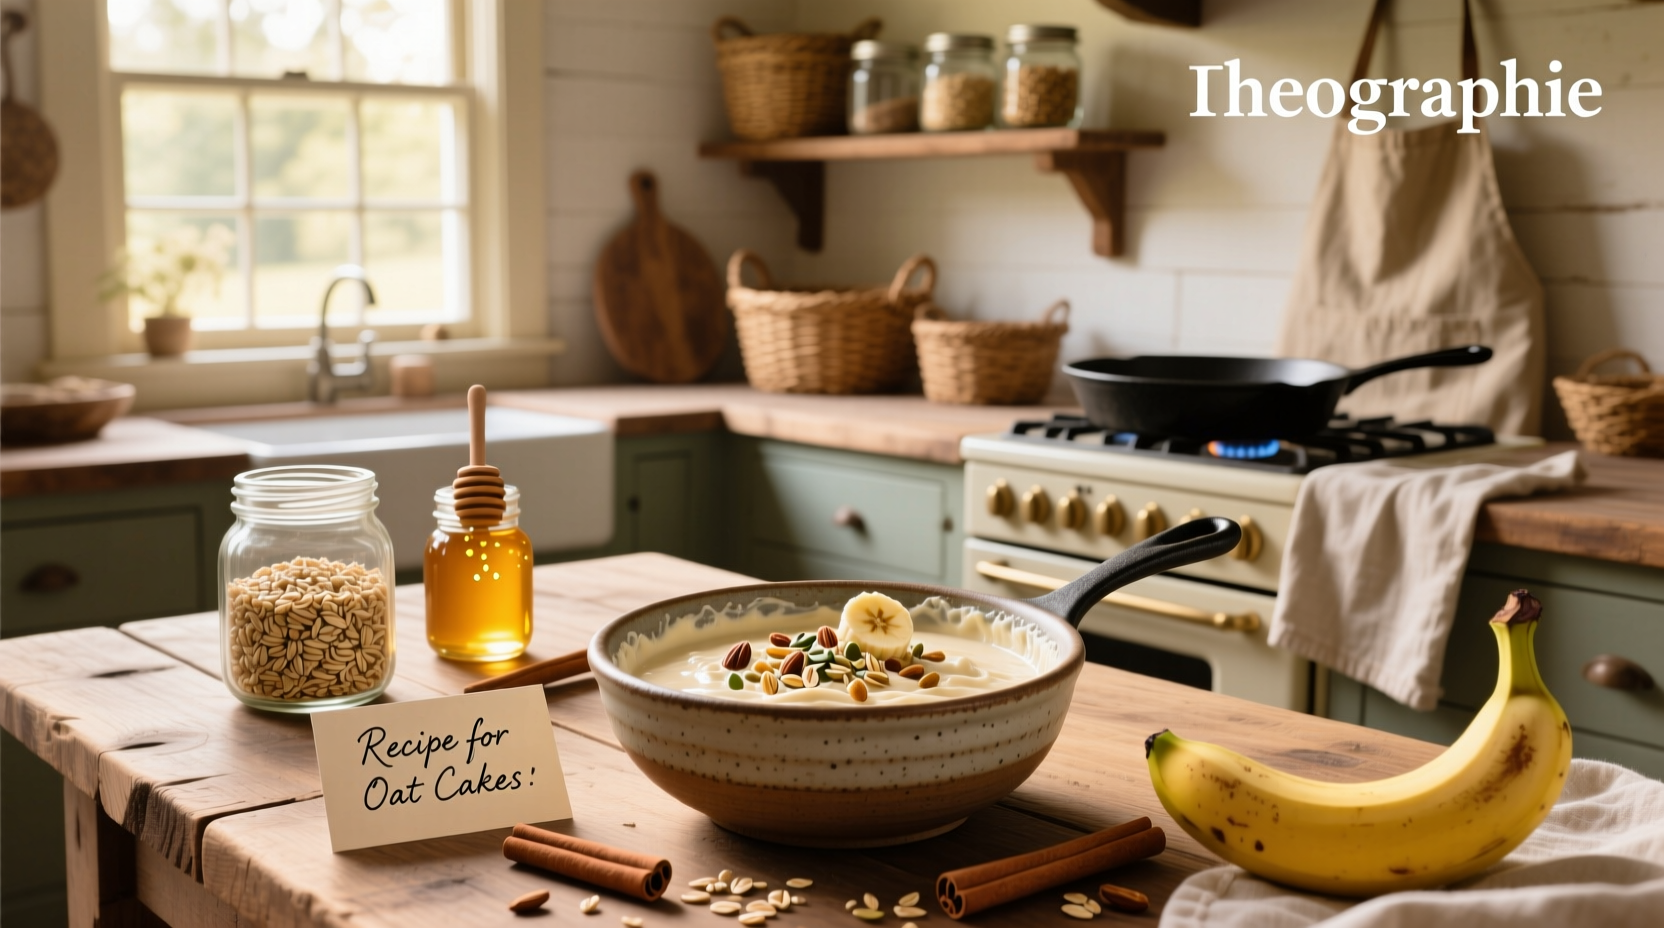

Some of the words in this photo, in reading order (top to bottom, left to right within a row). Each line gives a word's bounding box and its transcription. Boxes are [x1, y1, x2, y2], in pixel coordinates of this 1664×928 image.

[357, 726, 460, 769] Recipe
[465, 717, 510, 765] for
[363, 775, 426, 811] Oat
